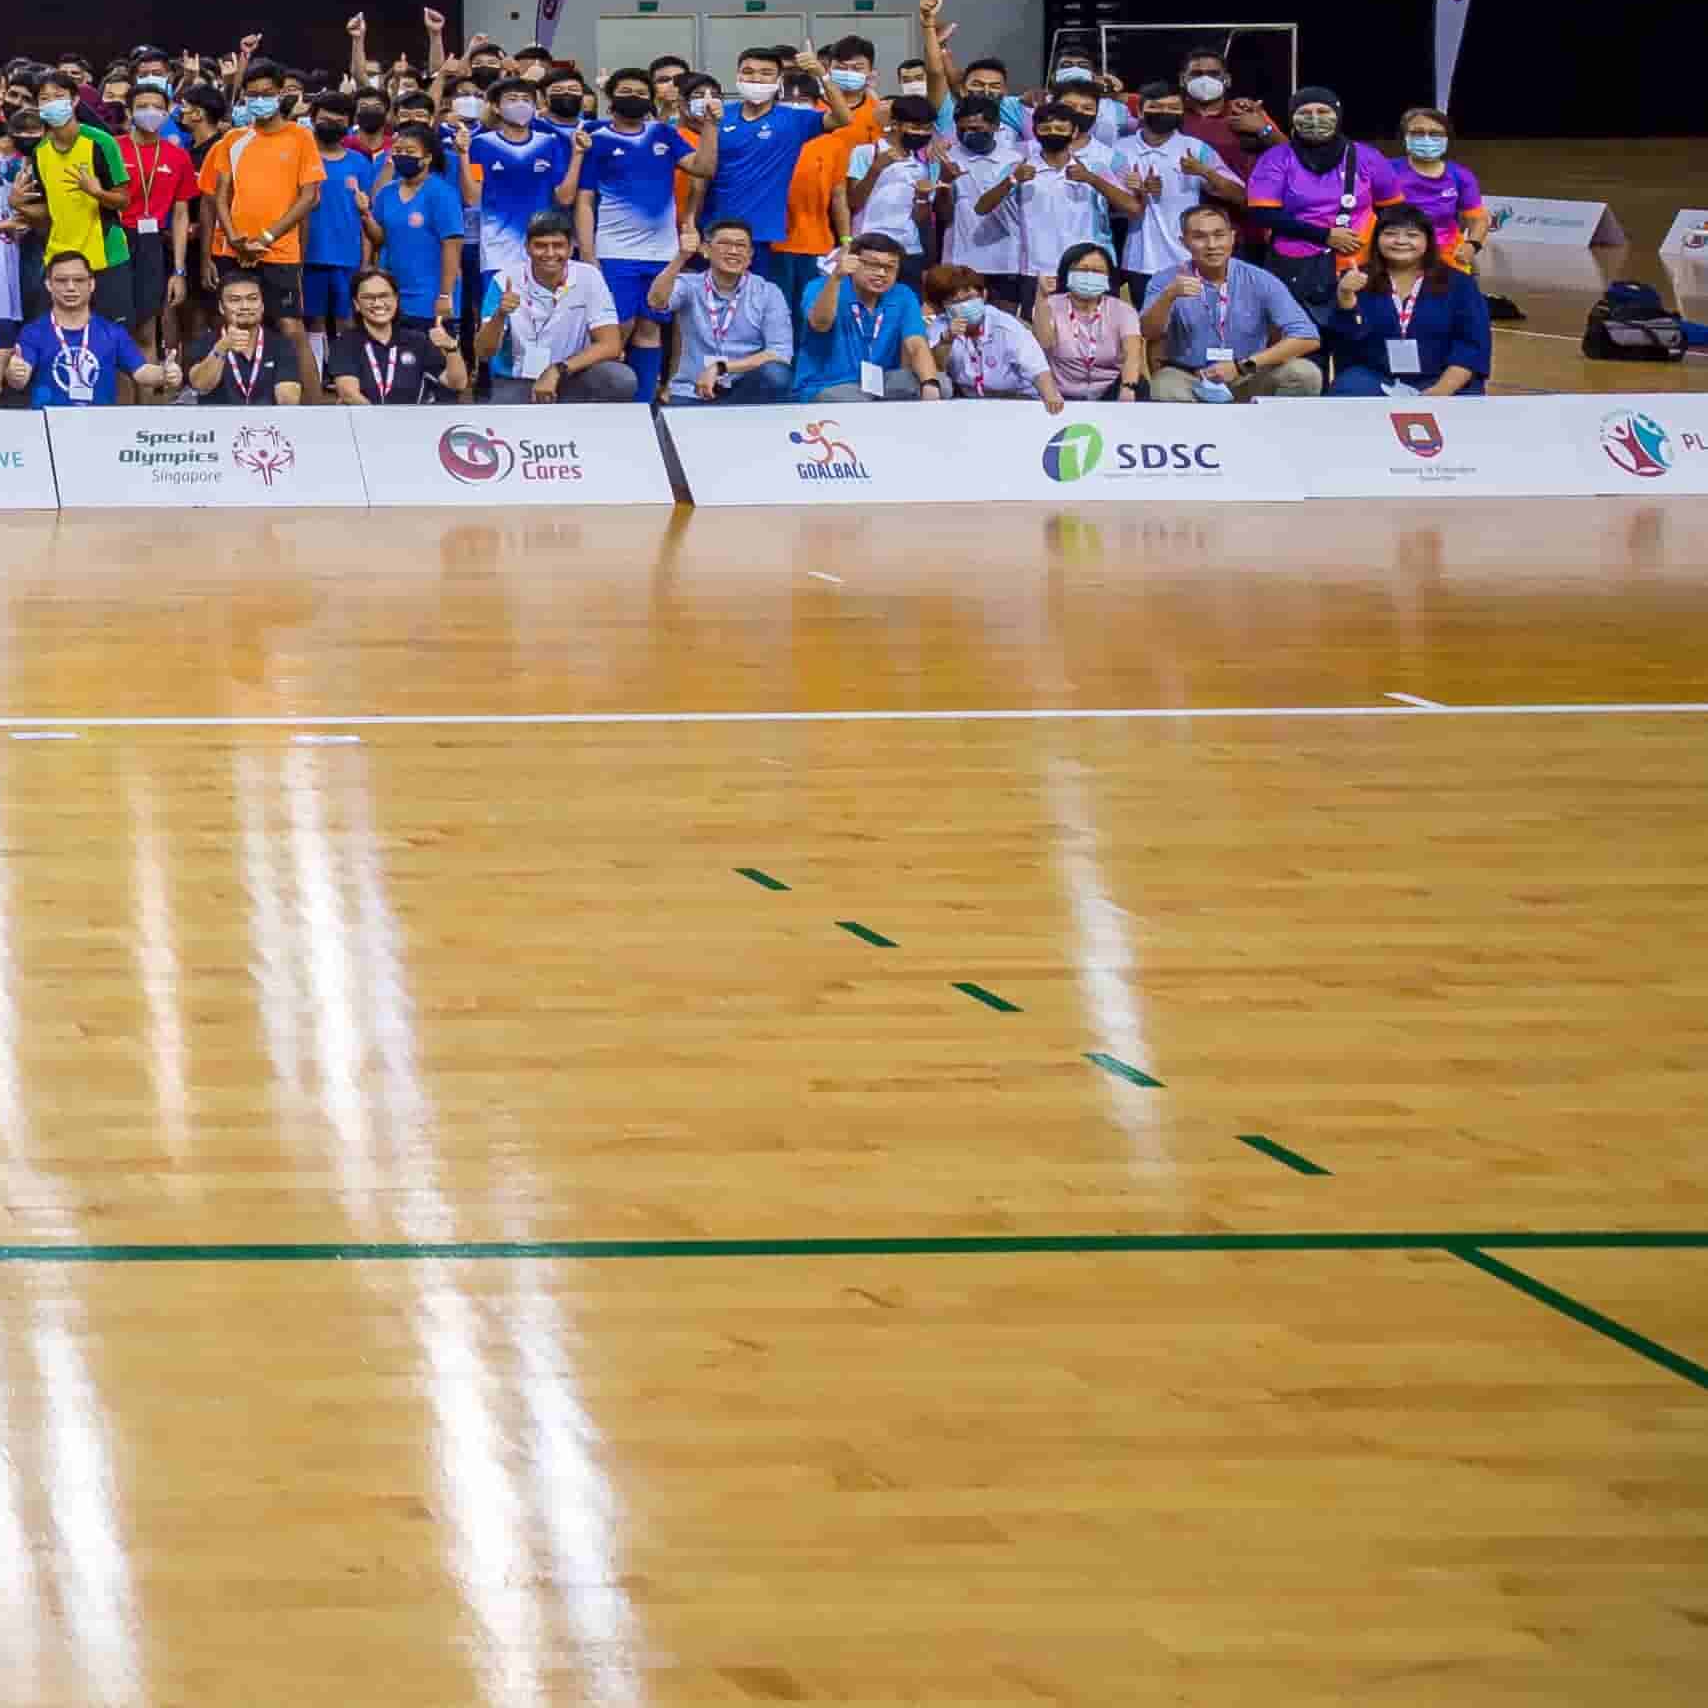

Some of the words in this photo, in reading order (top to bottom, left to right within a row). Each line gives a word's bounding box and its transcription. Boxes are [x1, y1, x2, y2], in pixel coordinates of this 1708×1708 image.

[135, 430, 216, 447] Special
[119, 449, 219, 466] Olympics
[519, 440, 579, 462] Sport
[1115, 443, 1221, 470] SDSC
[151, 469, 224, 485] Singapore
[522, 461, 583, 480] Cares
[796, 461, 871, 479] GOALBALL
